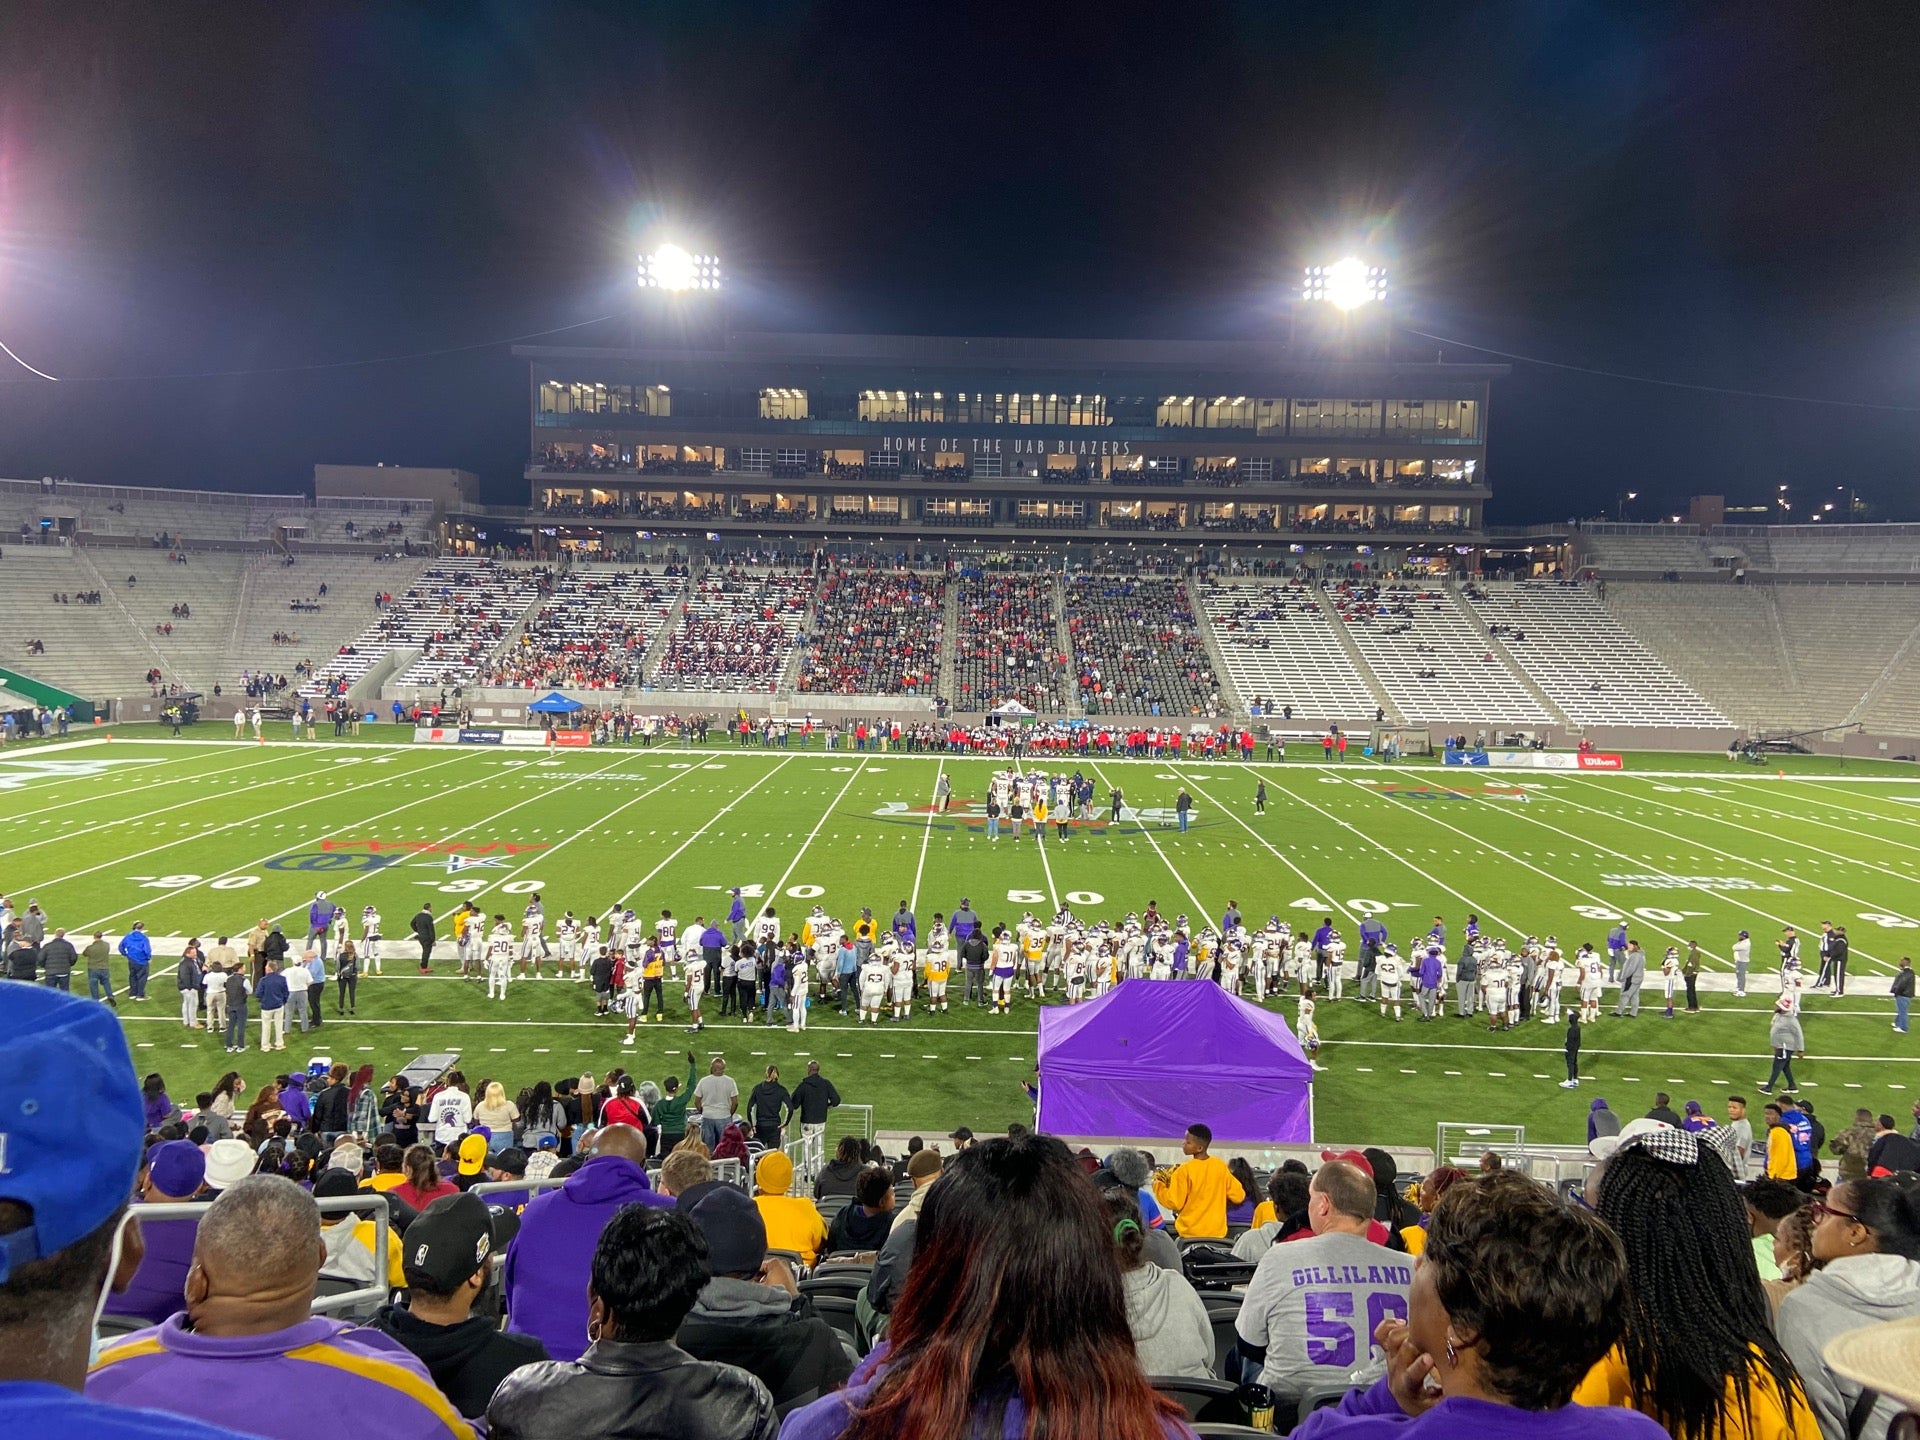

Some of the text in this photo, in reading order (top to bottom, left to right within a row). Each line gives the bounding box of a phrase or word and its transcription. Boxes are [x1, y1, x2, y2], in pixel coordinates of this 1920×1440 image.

[883, 437, 1130, 455] HOME OF THE UAB BLAZERS
[1583, 757, 1616, 767] Wilson
[437, 879, 546, 893] 30
[725, 884, 826, 898] 40
[1007, 890, 1105, 905] 50
[1289, 897, 1390, 913] 40
[1570, 905, 1684, 922] 30
[663, 926, 675, 938] 80
[761, 924, 775, 934] 99
[494, 940, 508, 953] 20
[823, 943, 837, 954] 73
[1031, 938, 1043, 949] 35
[1003, 951, 1013, 963] 71
[934, 960, 947, 972] 78
[1292, 1265, 1411, 1287] GILLILAND
